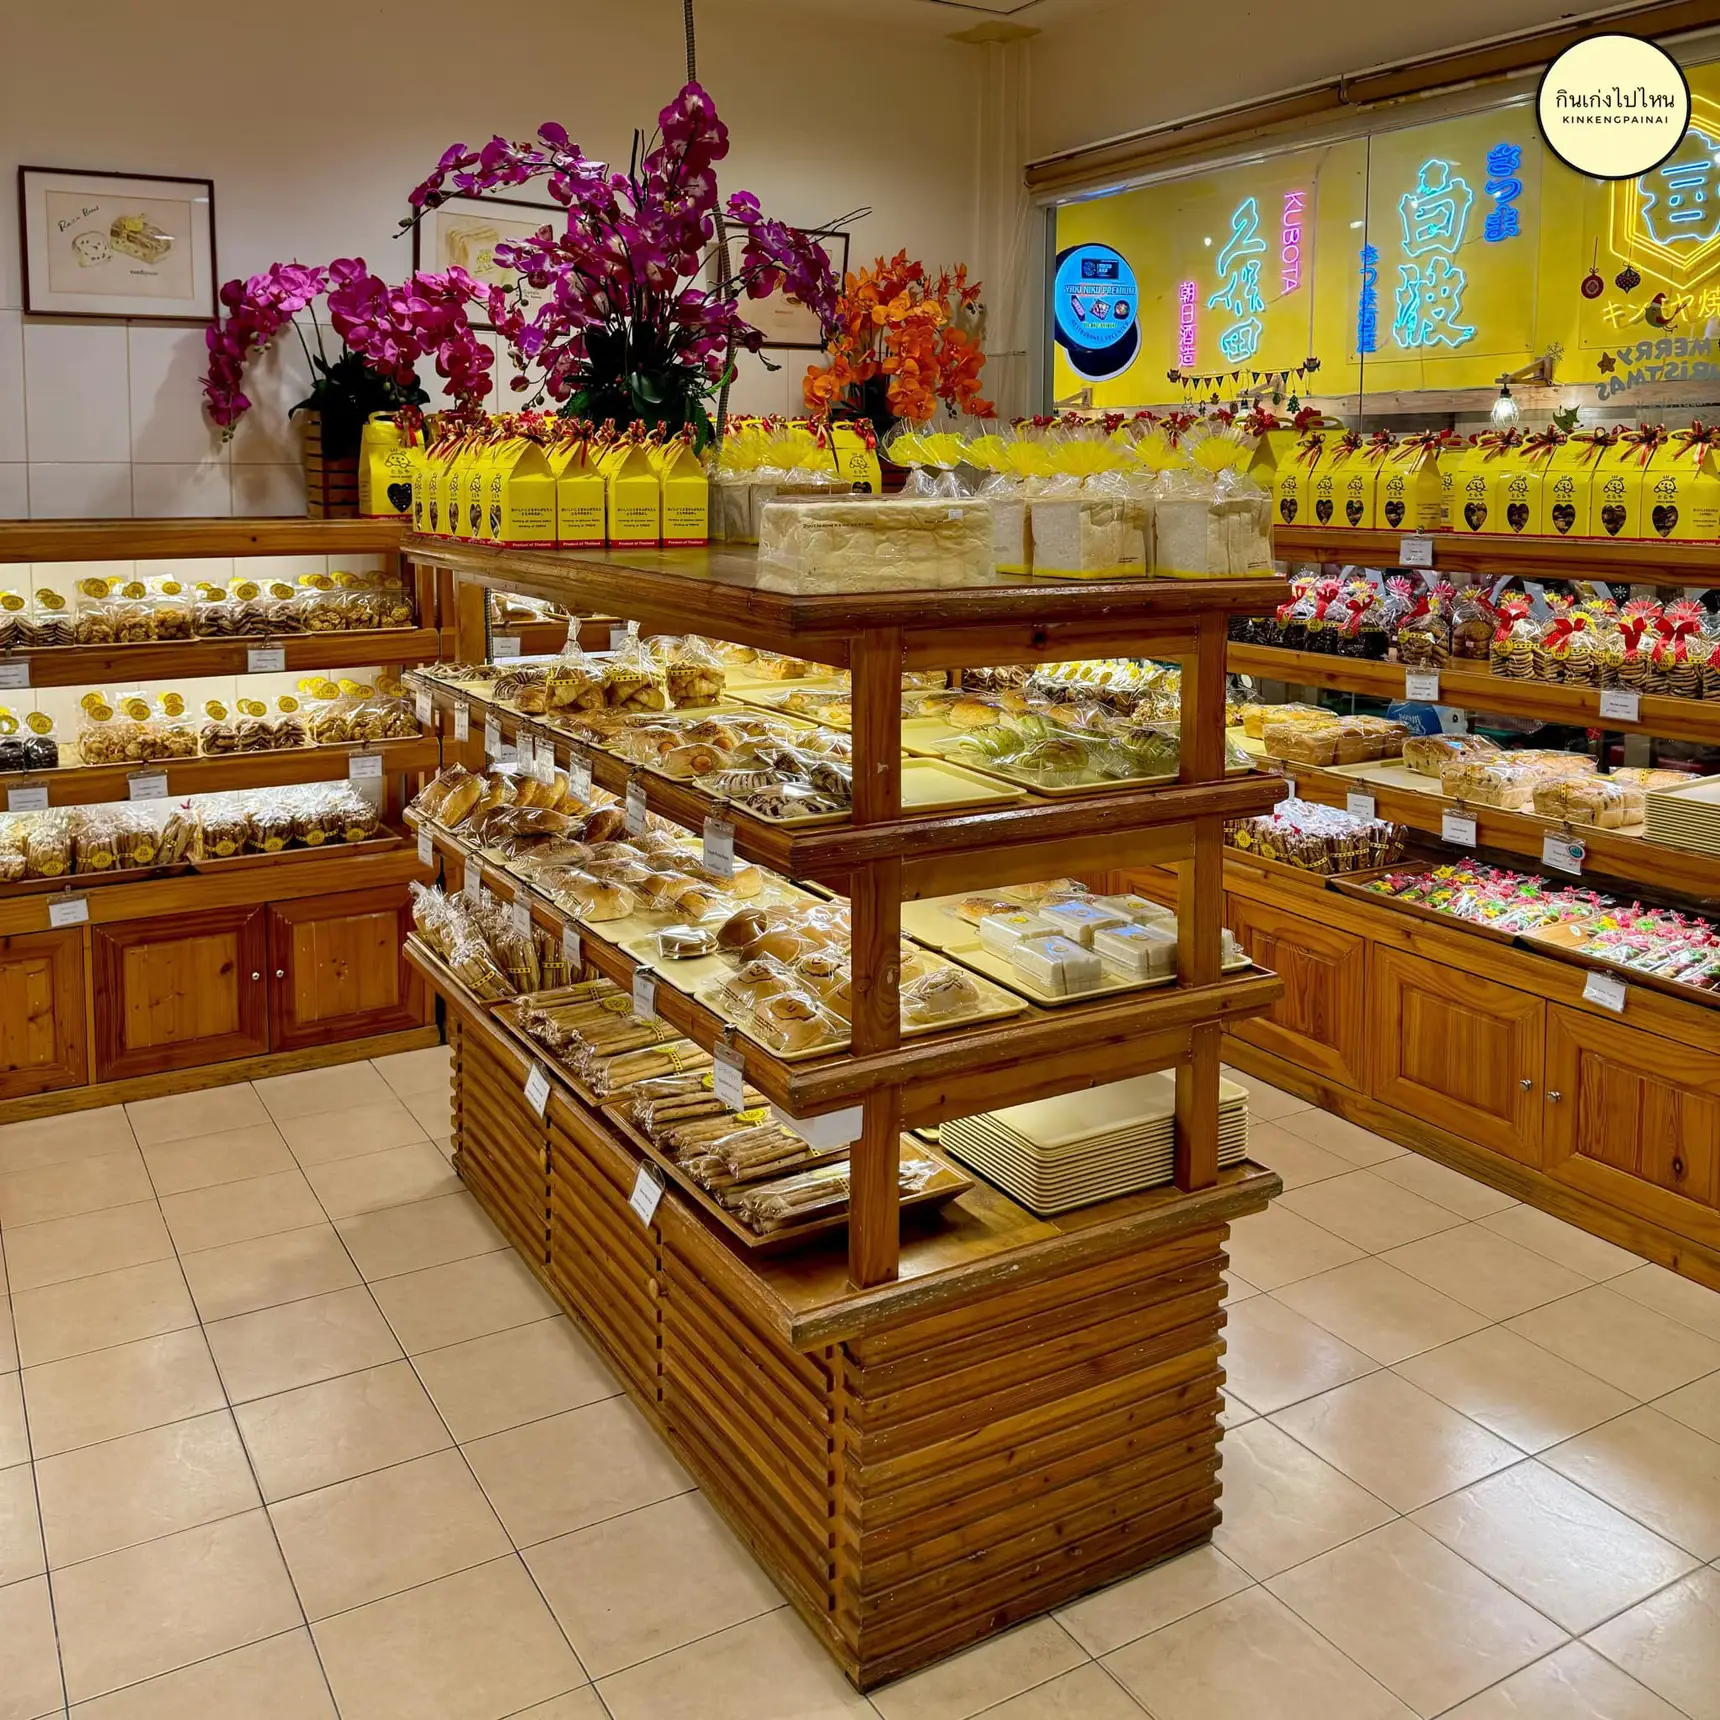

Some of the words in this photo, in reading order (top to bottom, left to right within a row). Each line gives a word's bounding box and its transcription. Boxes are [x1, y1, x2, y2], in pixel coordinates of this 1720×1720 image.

[1281, 191, 1306, 295] KUBOTA
[1483, 143, 1522, 243] さつま
[1208, 197, 1267, 363] 久保田
